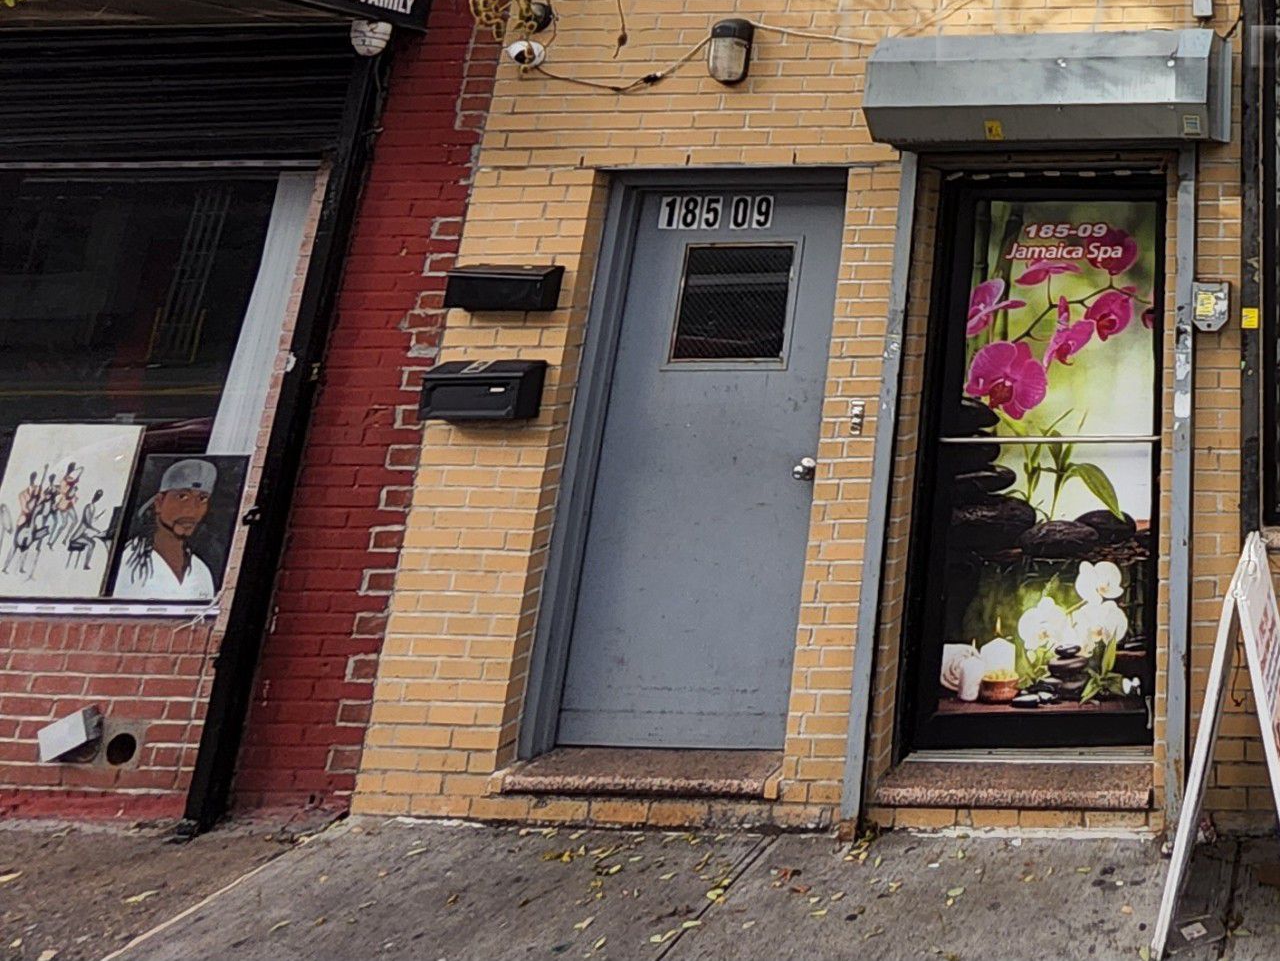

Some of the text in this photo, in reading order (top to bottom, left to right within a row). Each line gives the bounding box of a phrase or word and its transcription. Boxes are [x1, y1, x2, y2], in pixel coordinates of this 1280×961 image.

[665, 196, 772, 228] 185 09
[1025, 223, 1108, 238] 185-09
[1005, 243, 1124, 264] Jamaica Spa
